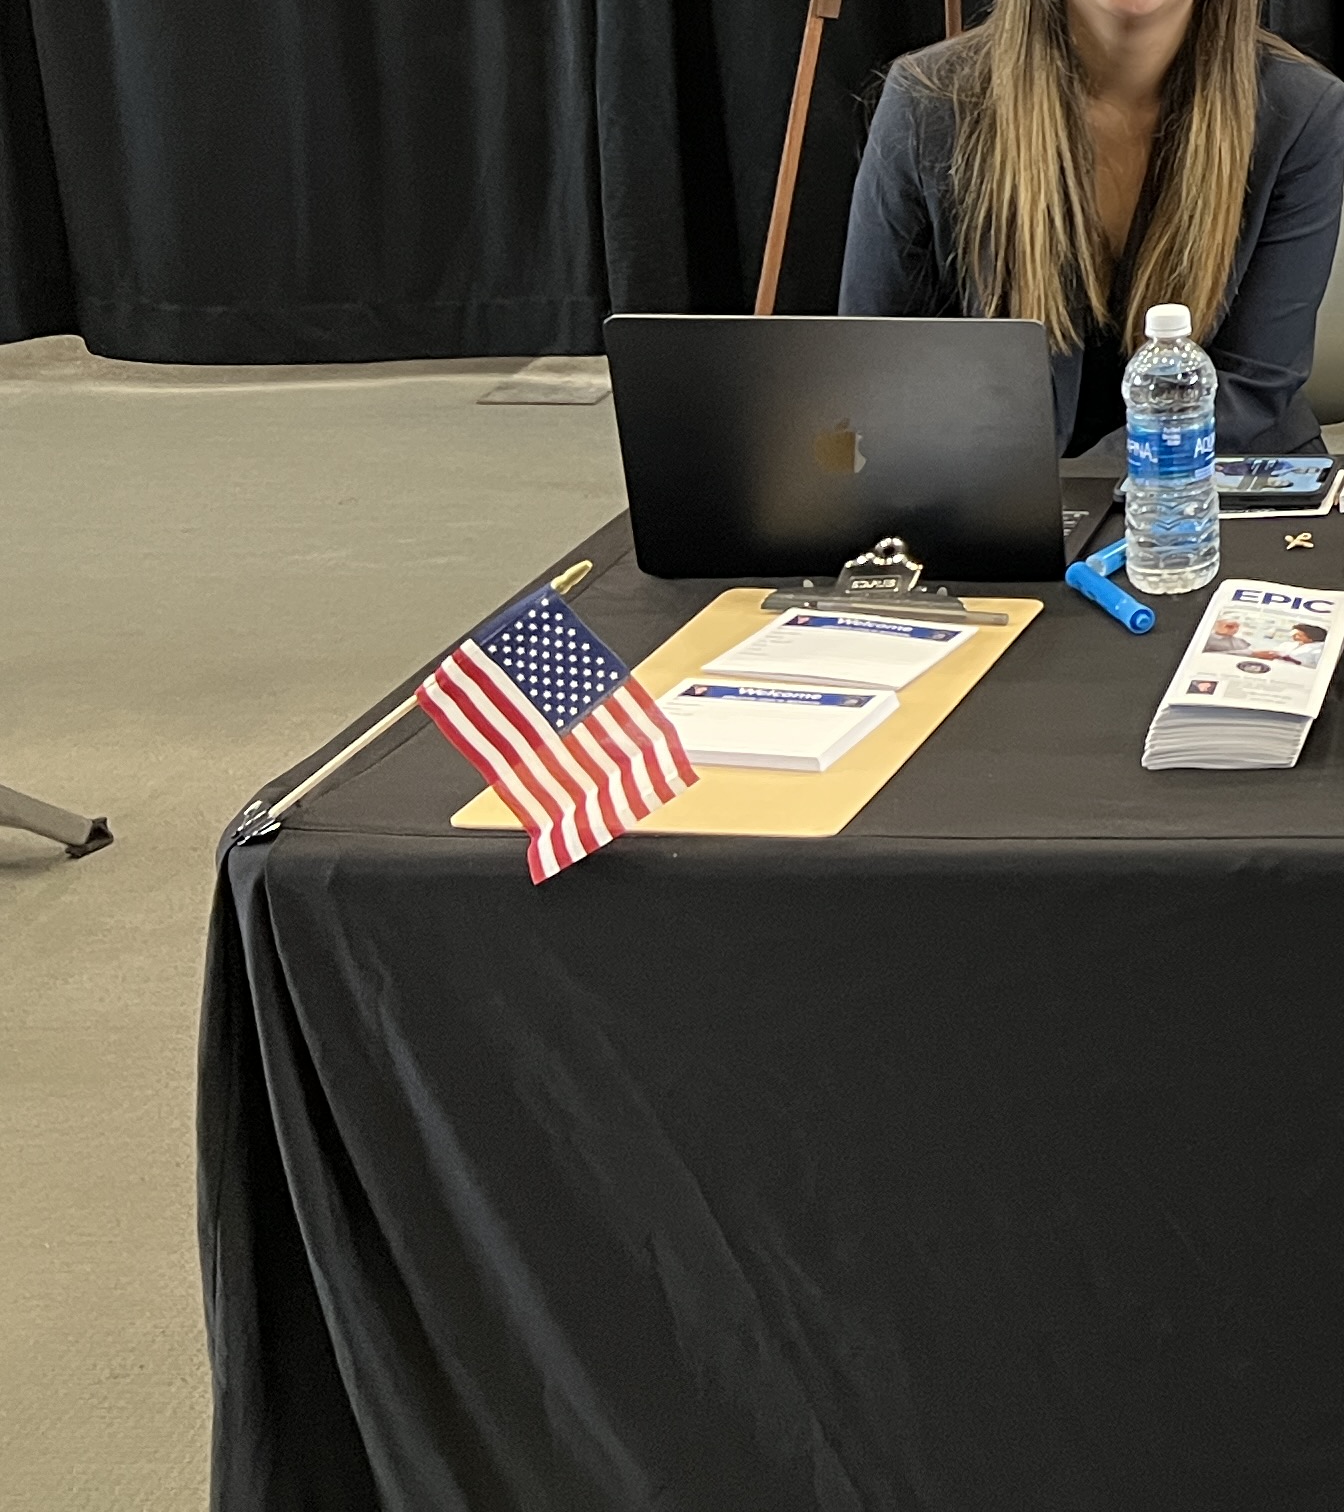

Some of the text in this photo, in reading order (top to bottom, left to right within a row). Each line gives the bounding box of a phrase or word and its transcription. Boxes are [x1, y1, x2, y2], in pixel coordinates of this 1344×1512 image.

[1231, 588, 1335, 614] EPIC
[836, 617, 914, 634] Welcome
[737, 686, 823, 701] Welcome
